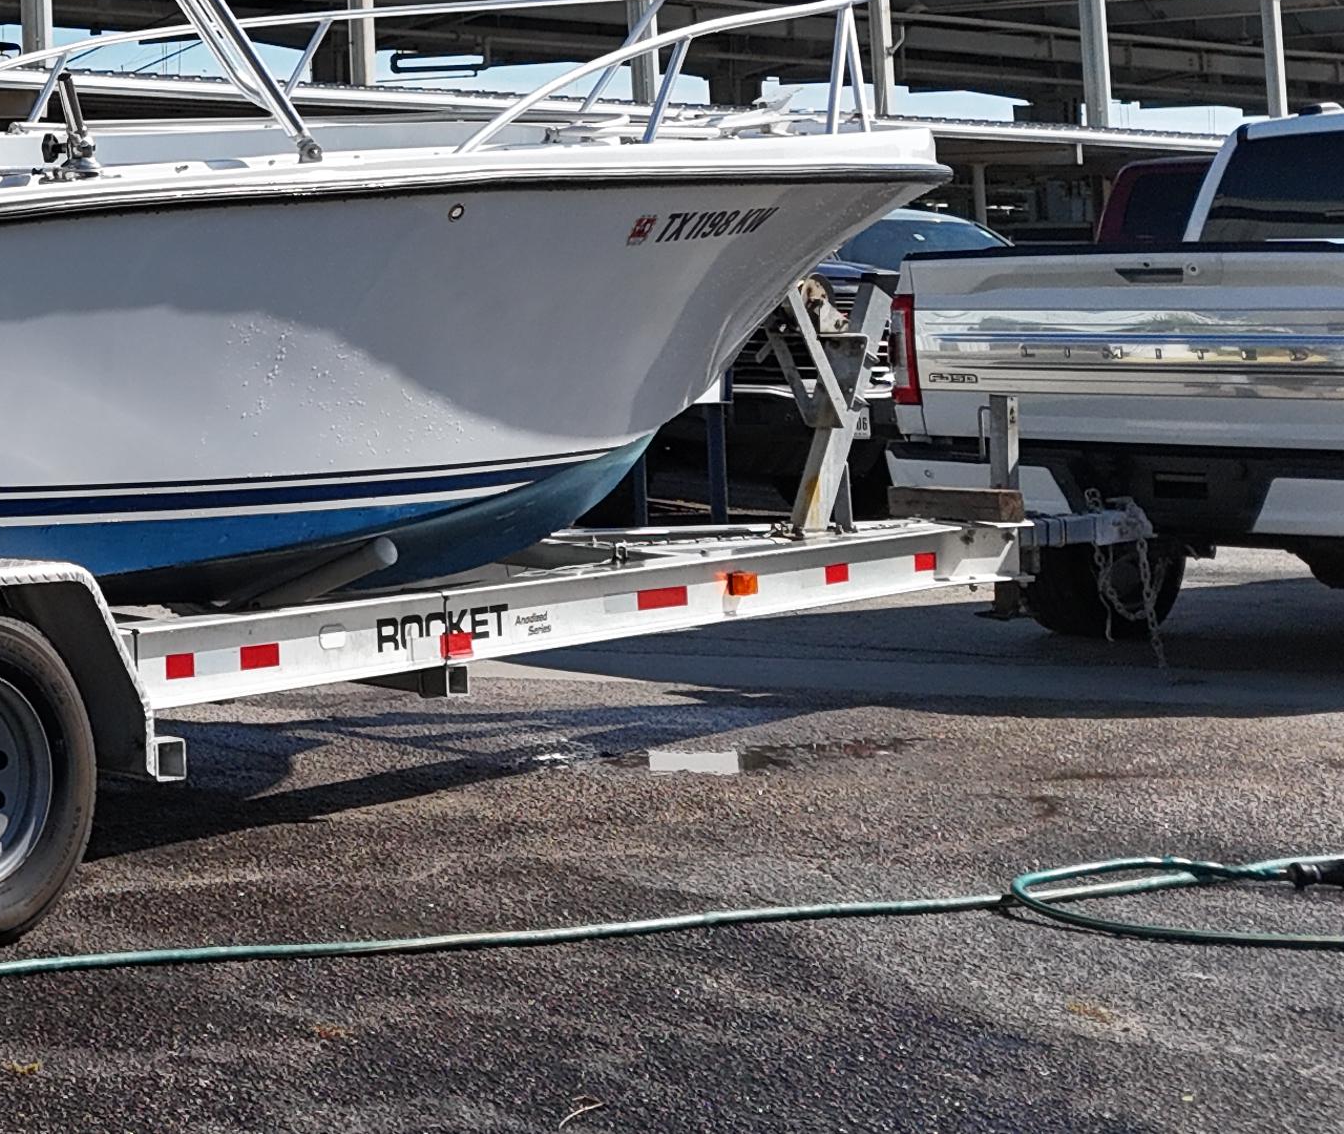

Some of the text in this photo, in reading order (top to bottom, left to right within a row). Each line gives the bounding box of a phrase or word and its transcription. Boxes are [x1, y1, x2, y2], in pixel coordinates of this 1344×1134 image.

[654, 212, 698, 243] TX
[727, 206, 780, 236] KW
[376, 603, 509, 653] ROCKET
[527, 623, 552, 636] Series
